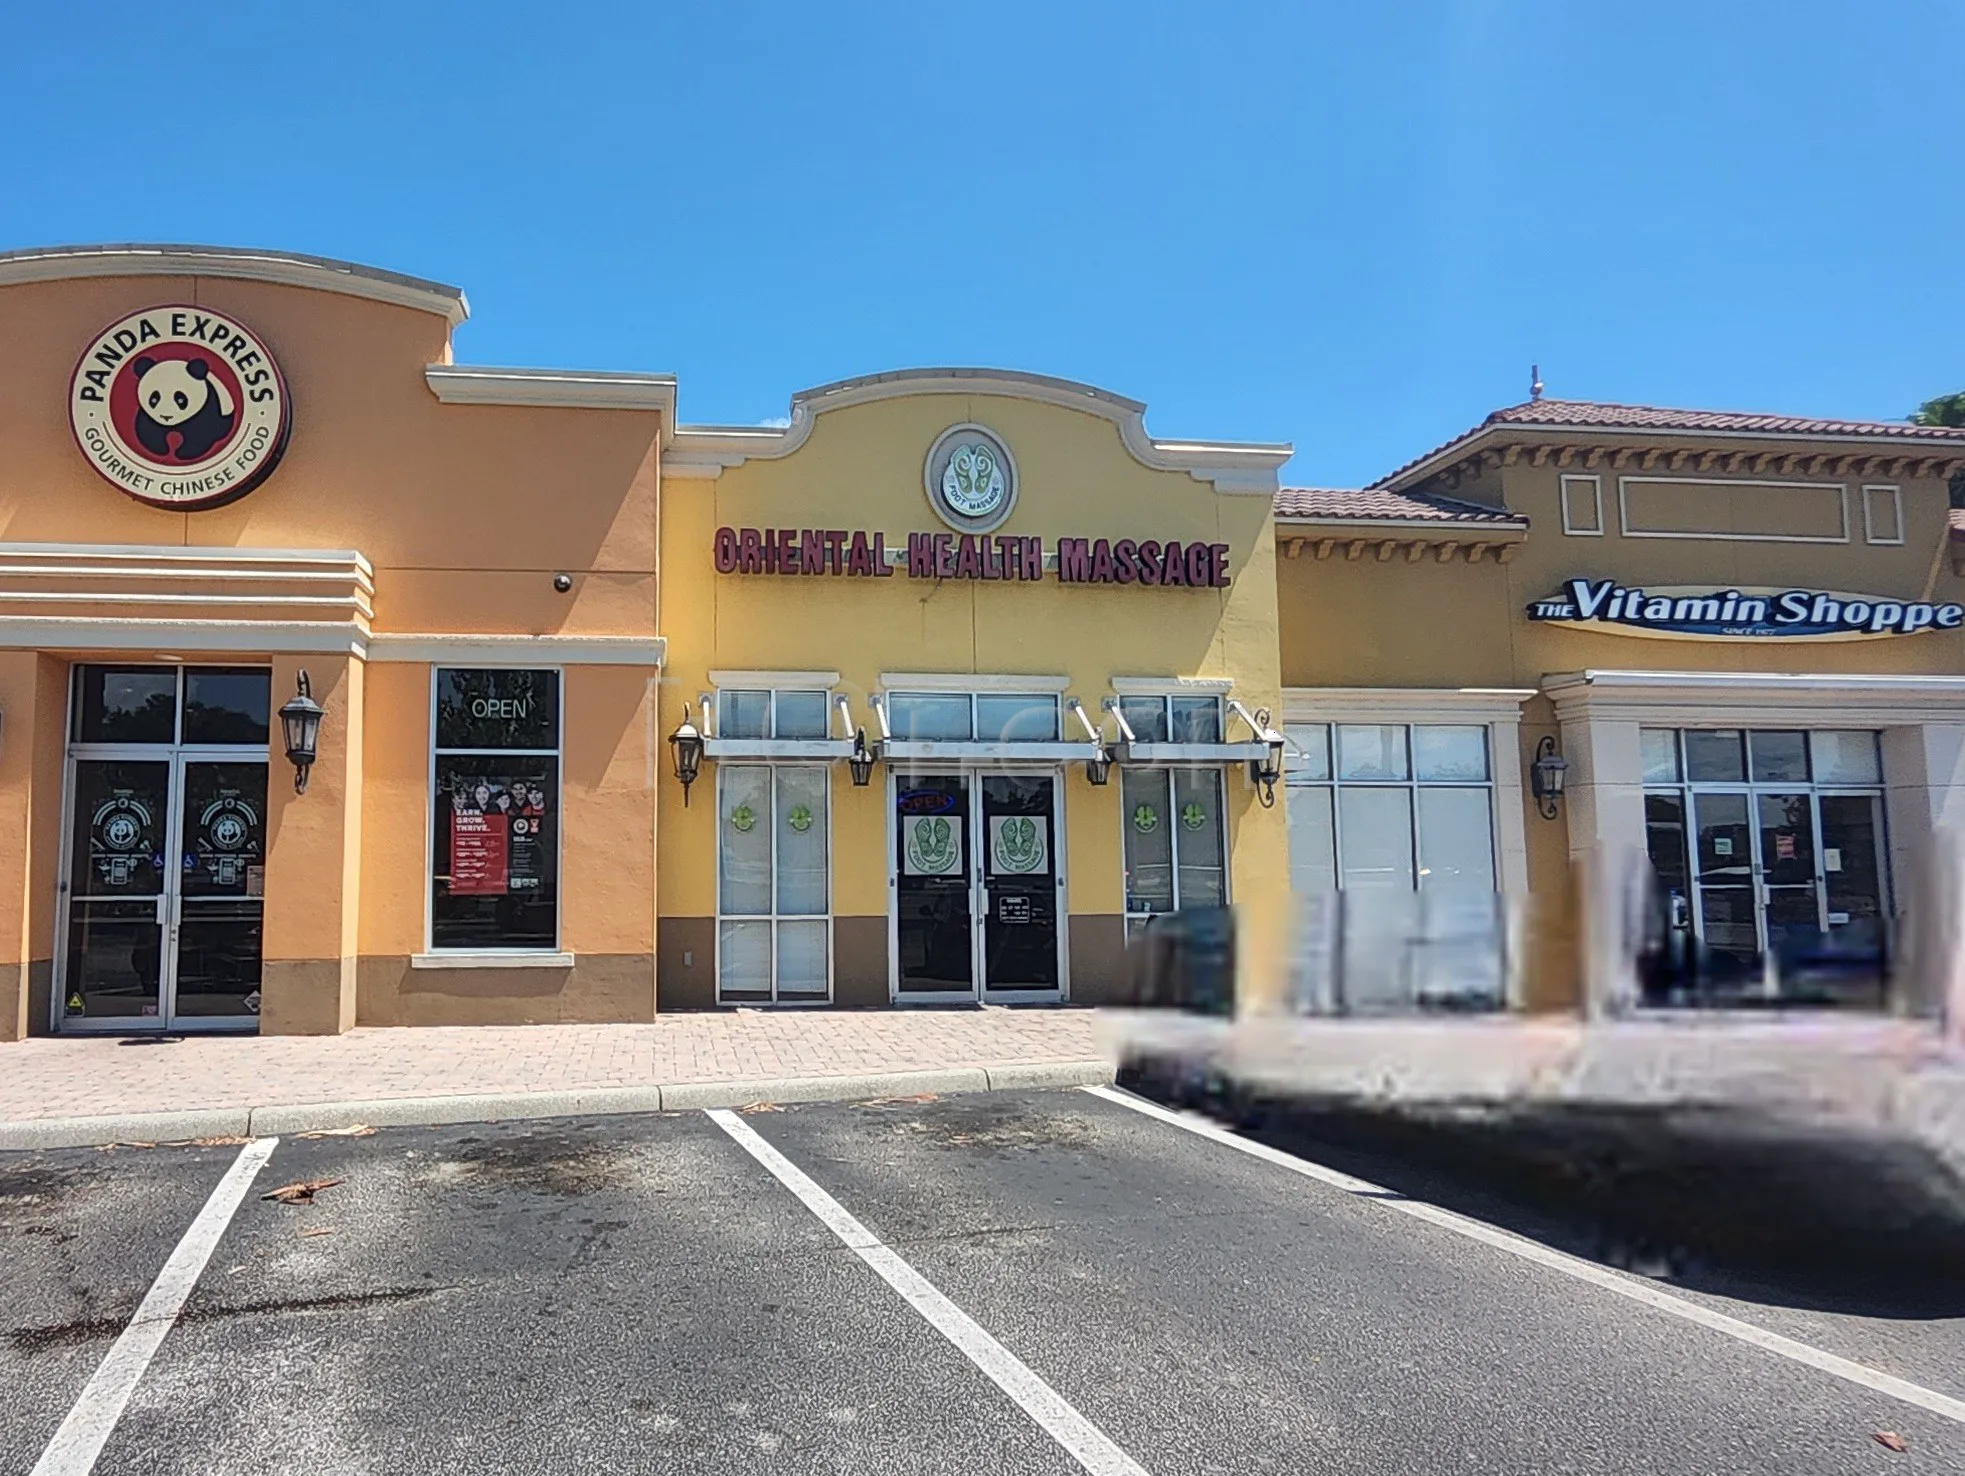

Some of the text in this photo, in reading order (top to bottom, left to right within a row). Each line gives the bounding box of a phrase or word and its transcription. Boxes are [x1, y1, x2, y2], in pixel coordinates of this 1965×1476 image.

[80, 313, 274, 403] PANDA EXPRESS
[85, 426, 270, 495] GOURMET CHINESE FOOD
[949, 484, 966, 505] FOOT
[714, 526, 1231, 587] ORIENTAL HEALTH MASSAGE
[1534, 580, 1964, 632] THE Vitamin Shoppe
[472, 698, 527, 719] OPEN
[902, 796, 947, 811] OPEN
[456, 816, 485, 824] GROW.
[456, 824, 491, 832] THRIVE.
